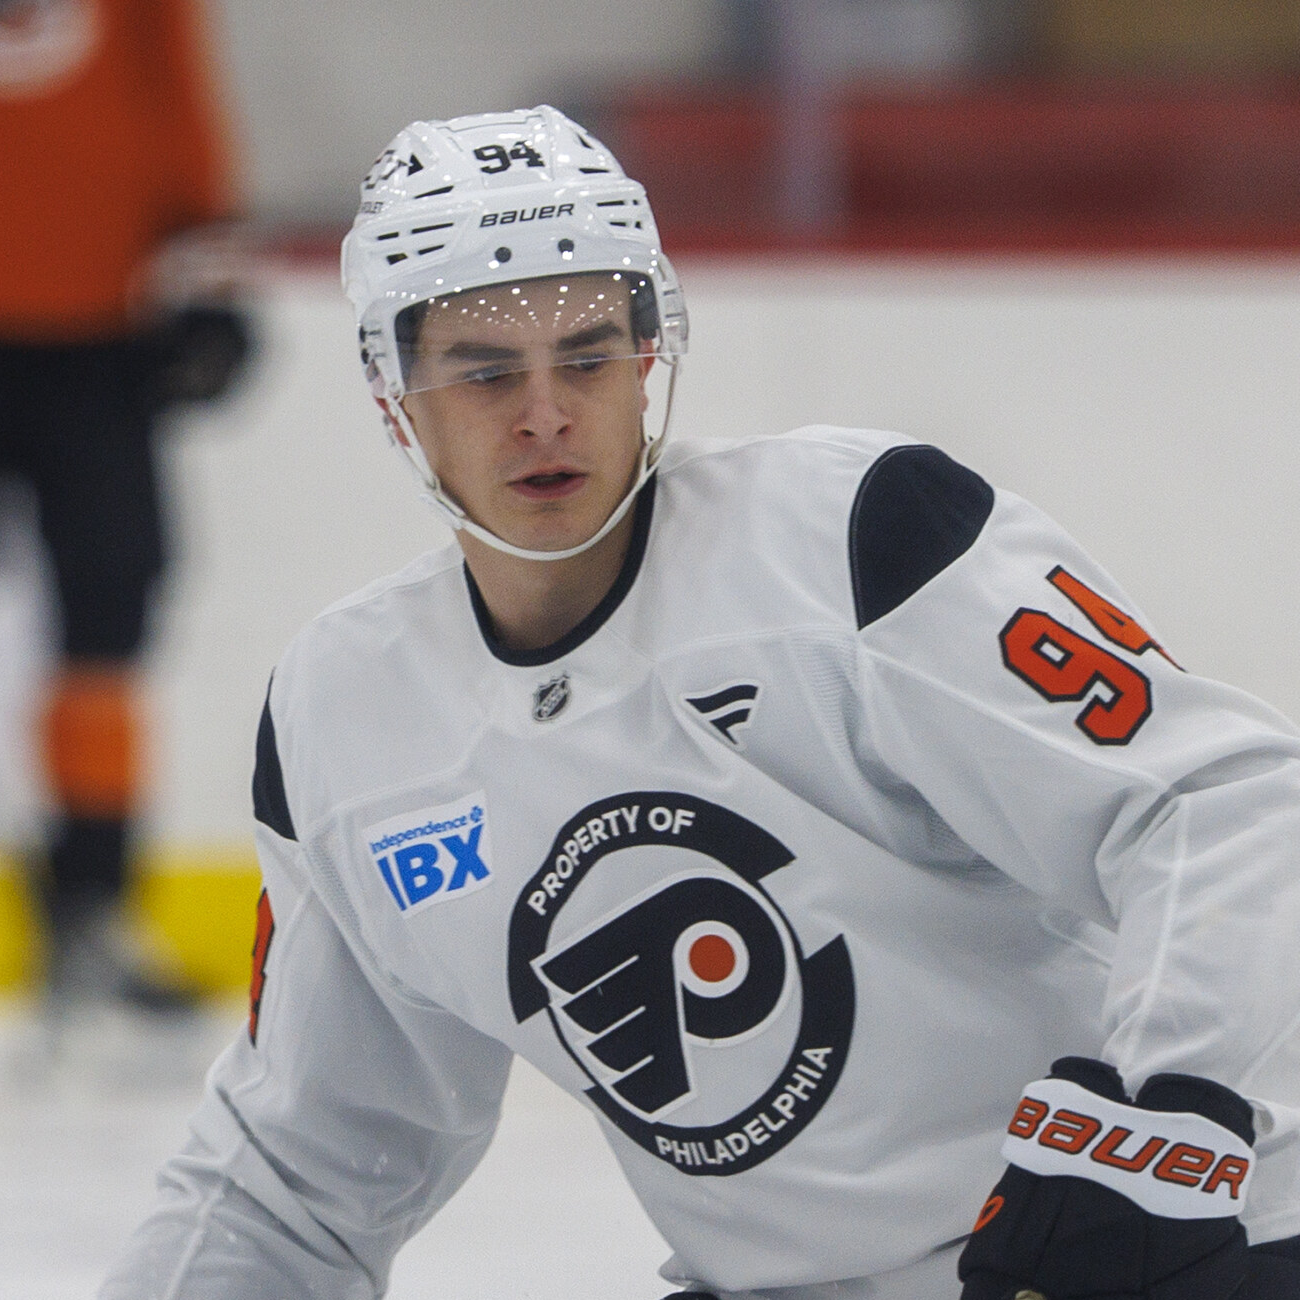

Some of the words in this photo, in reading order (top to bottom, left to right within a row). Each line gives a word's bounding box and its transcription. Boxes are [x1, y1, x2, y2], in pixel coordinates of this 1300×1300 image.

[473, 140, 546, 175] 94
[479, 202, 575, 229] BAUER
[998, 564, 1188, 746] 94
[370, 815, 468, 855] Independence
[377, 822, 491, 912] IBX
[527, 804, 640, 916] PROPERTY
[651, 805, 696, 836] OF
[655, 1045, 834, 1167] PHILADELPHIA
[1007, 1095, 1250, 1201] BAUER
